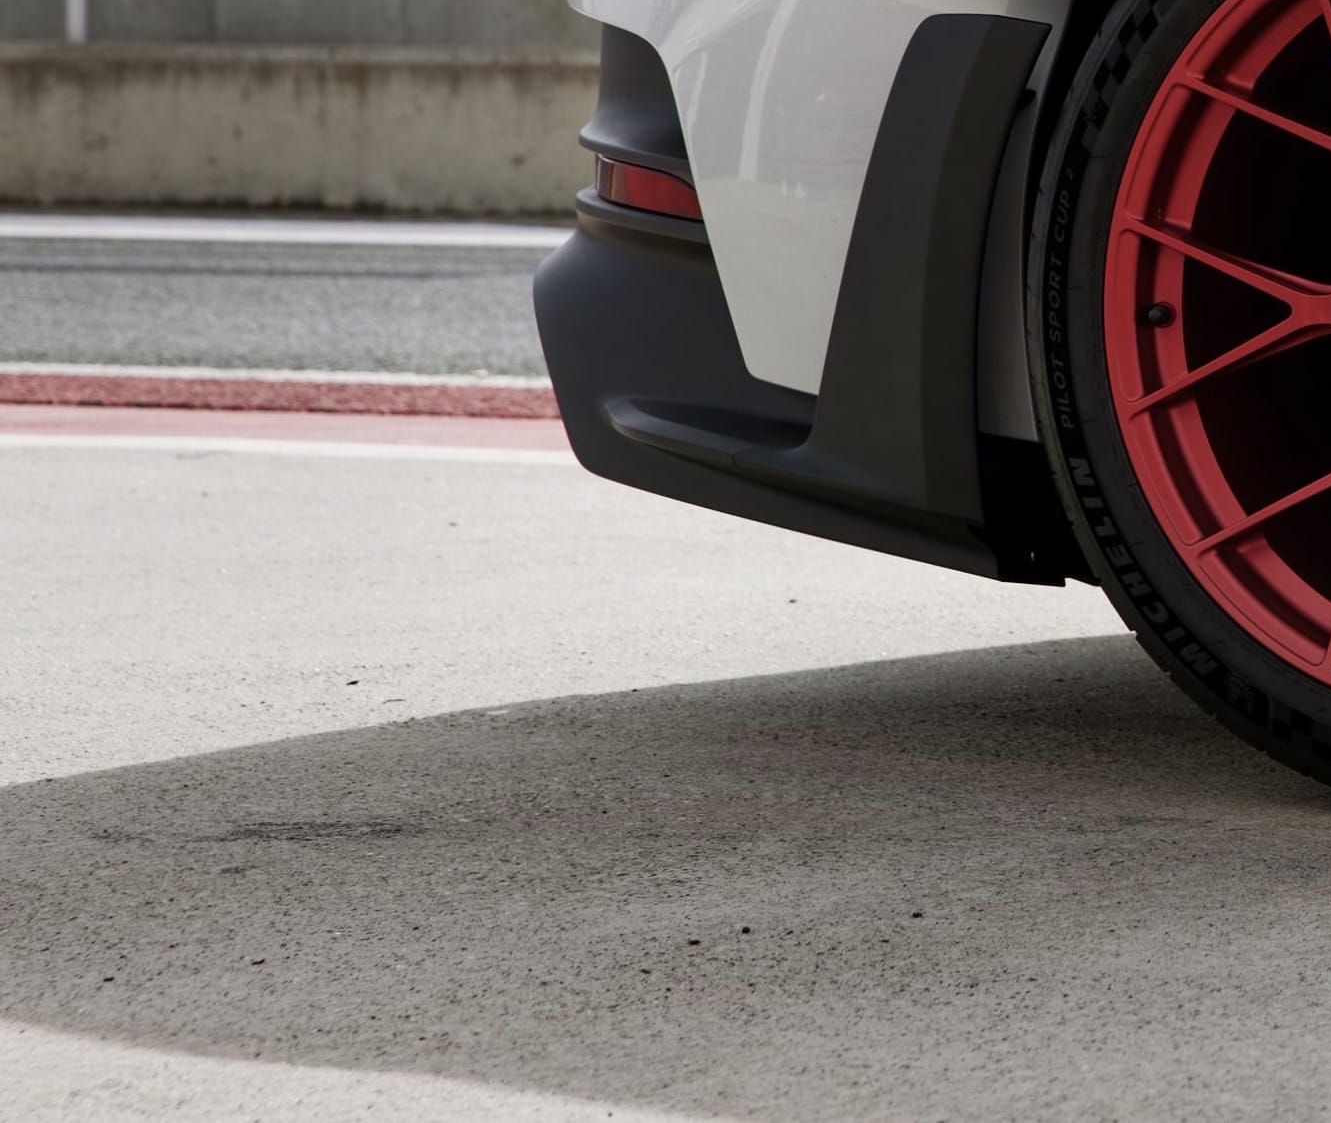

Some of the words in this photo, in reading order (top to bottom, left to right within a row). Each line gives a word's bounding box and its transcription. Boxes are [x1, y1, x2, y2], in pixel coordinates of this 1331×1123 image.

[1053, 189, 1074, 243] CUP
[1047, 254, 1069, 345] SPORT
[1048, 357, 1076, 430] PILOT
[1067, 457, 1219, 676] MICHELIN
